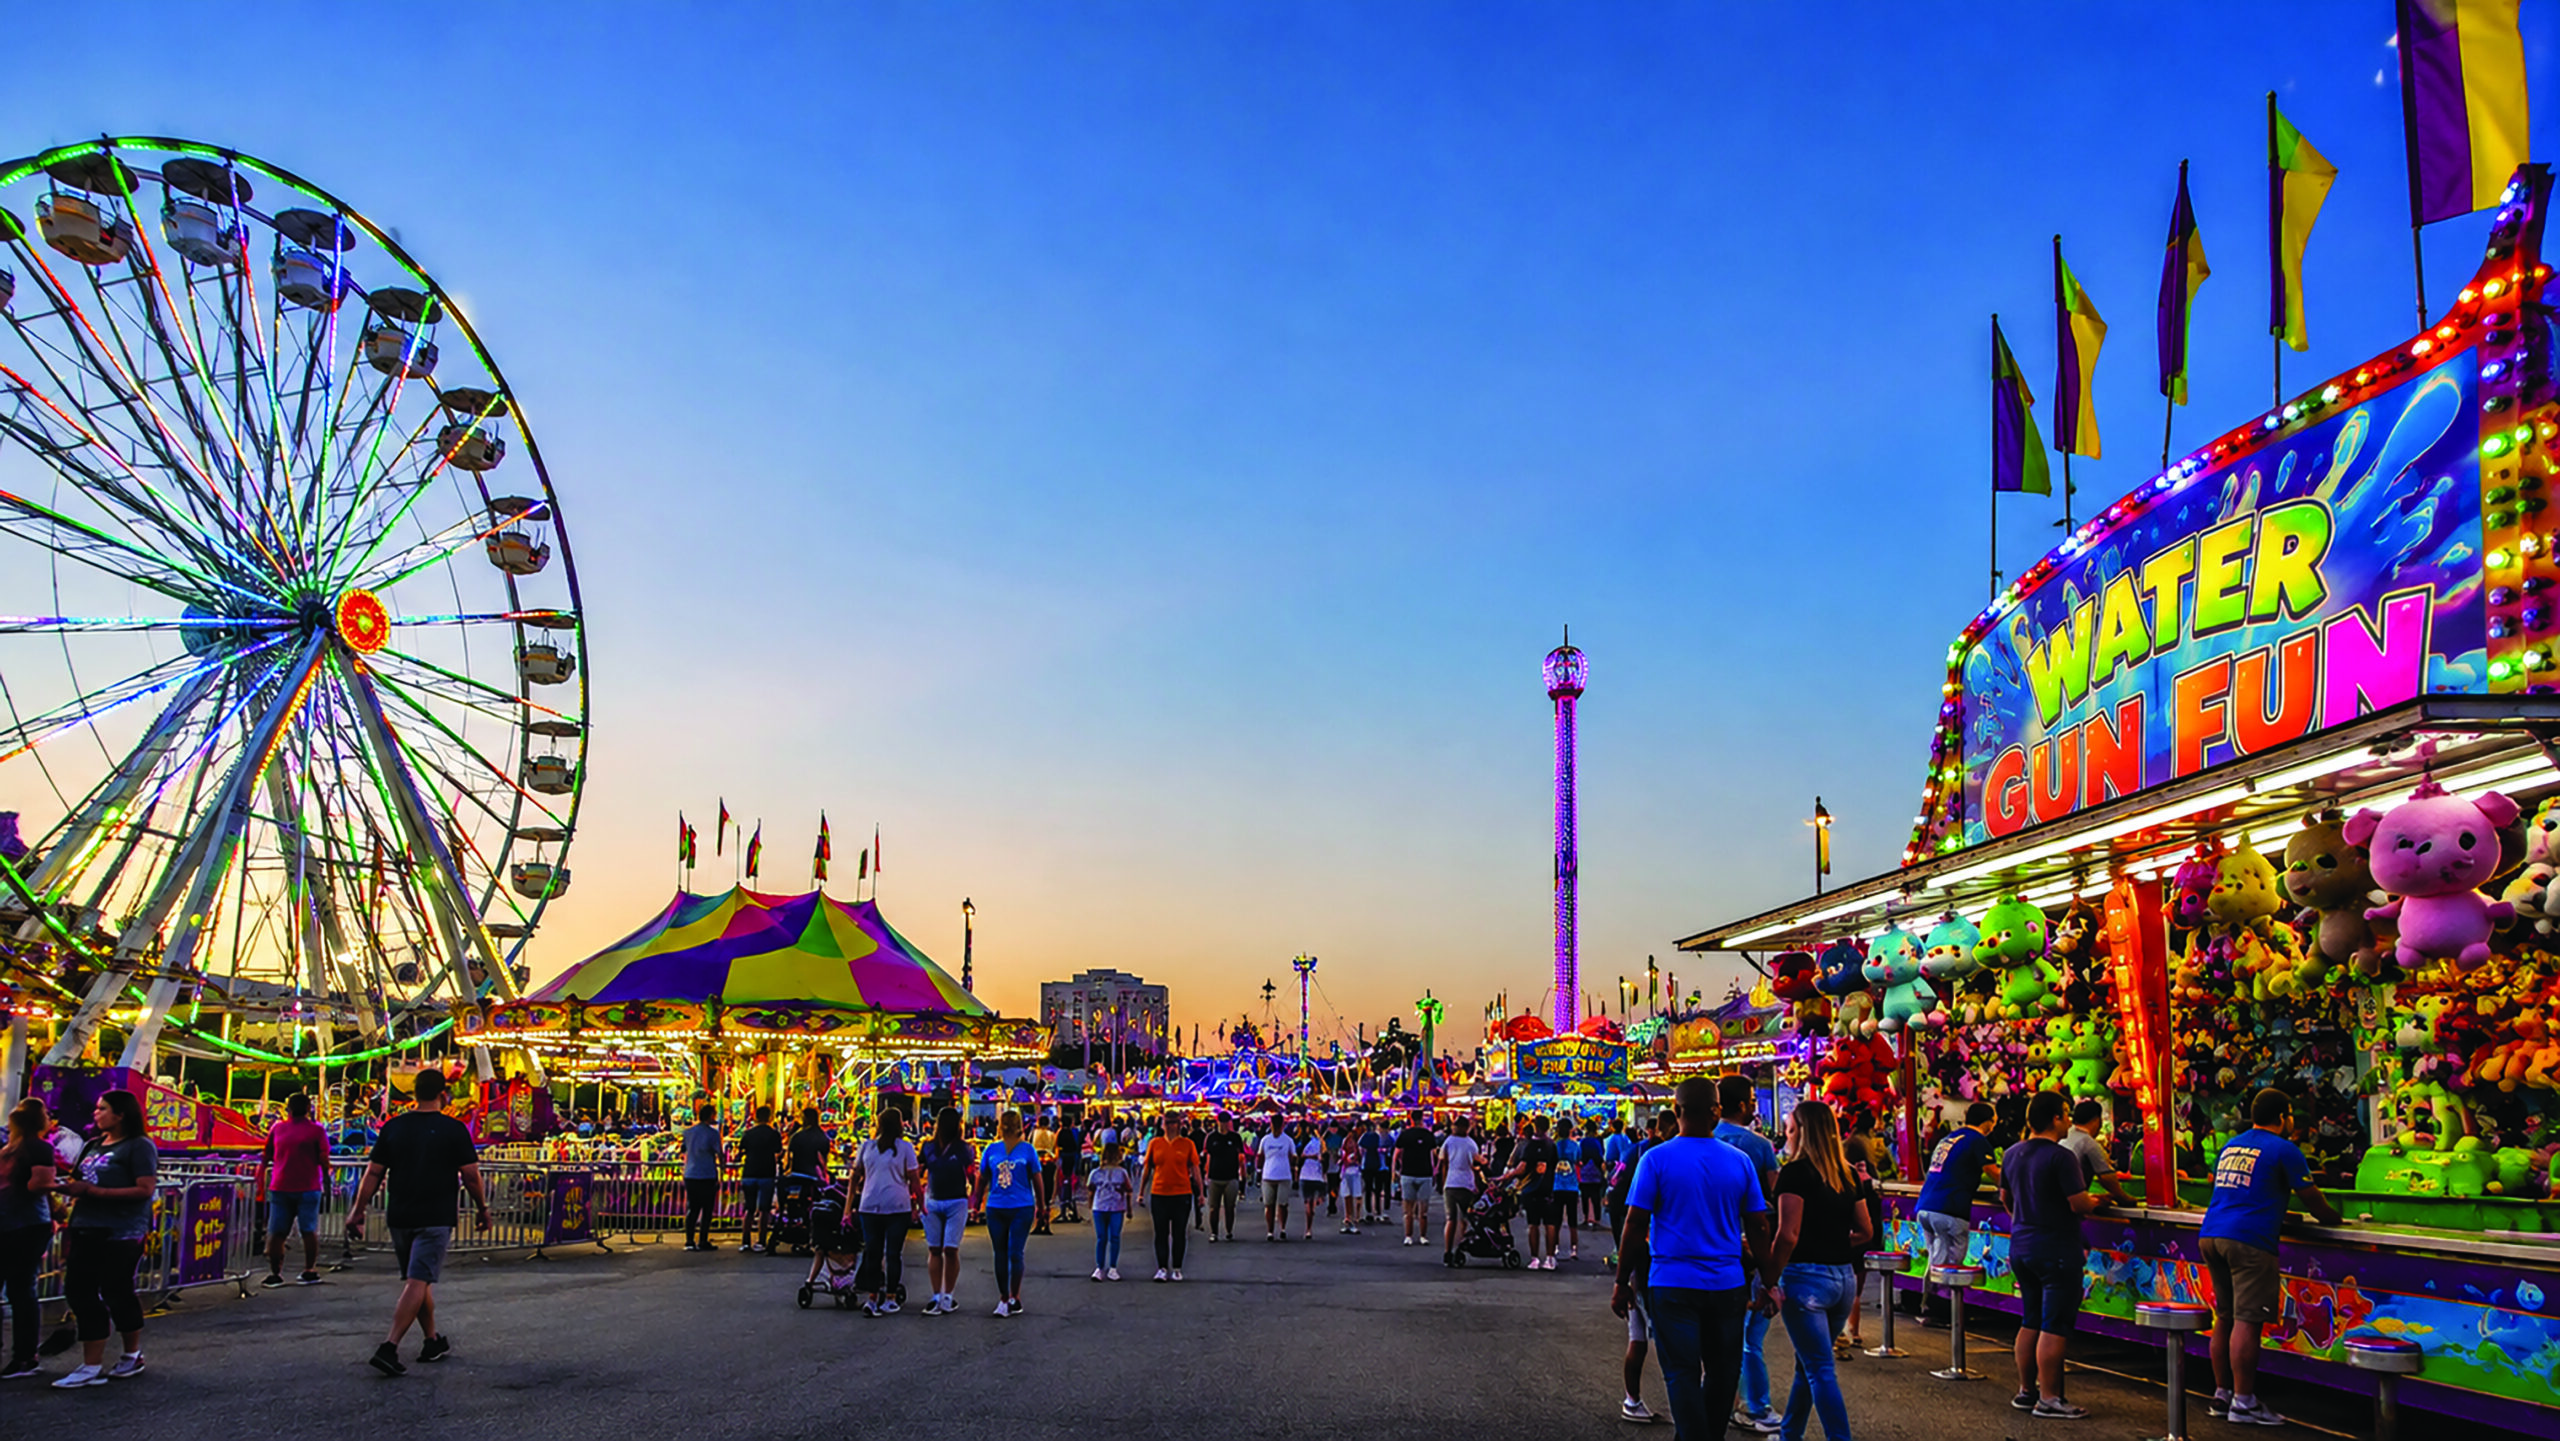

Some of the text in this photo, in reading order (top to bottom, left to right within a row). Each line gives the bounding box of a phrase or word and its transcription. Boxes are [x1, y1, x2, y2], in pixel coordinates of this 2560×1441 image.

[1983, 584, 2434, 838] GUN FUN
[2025, 498, 2334, 728] WATER
